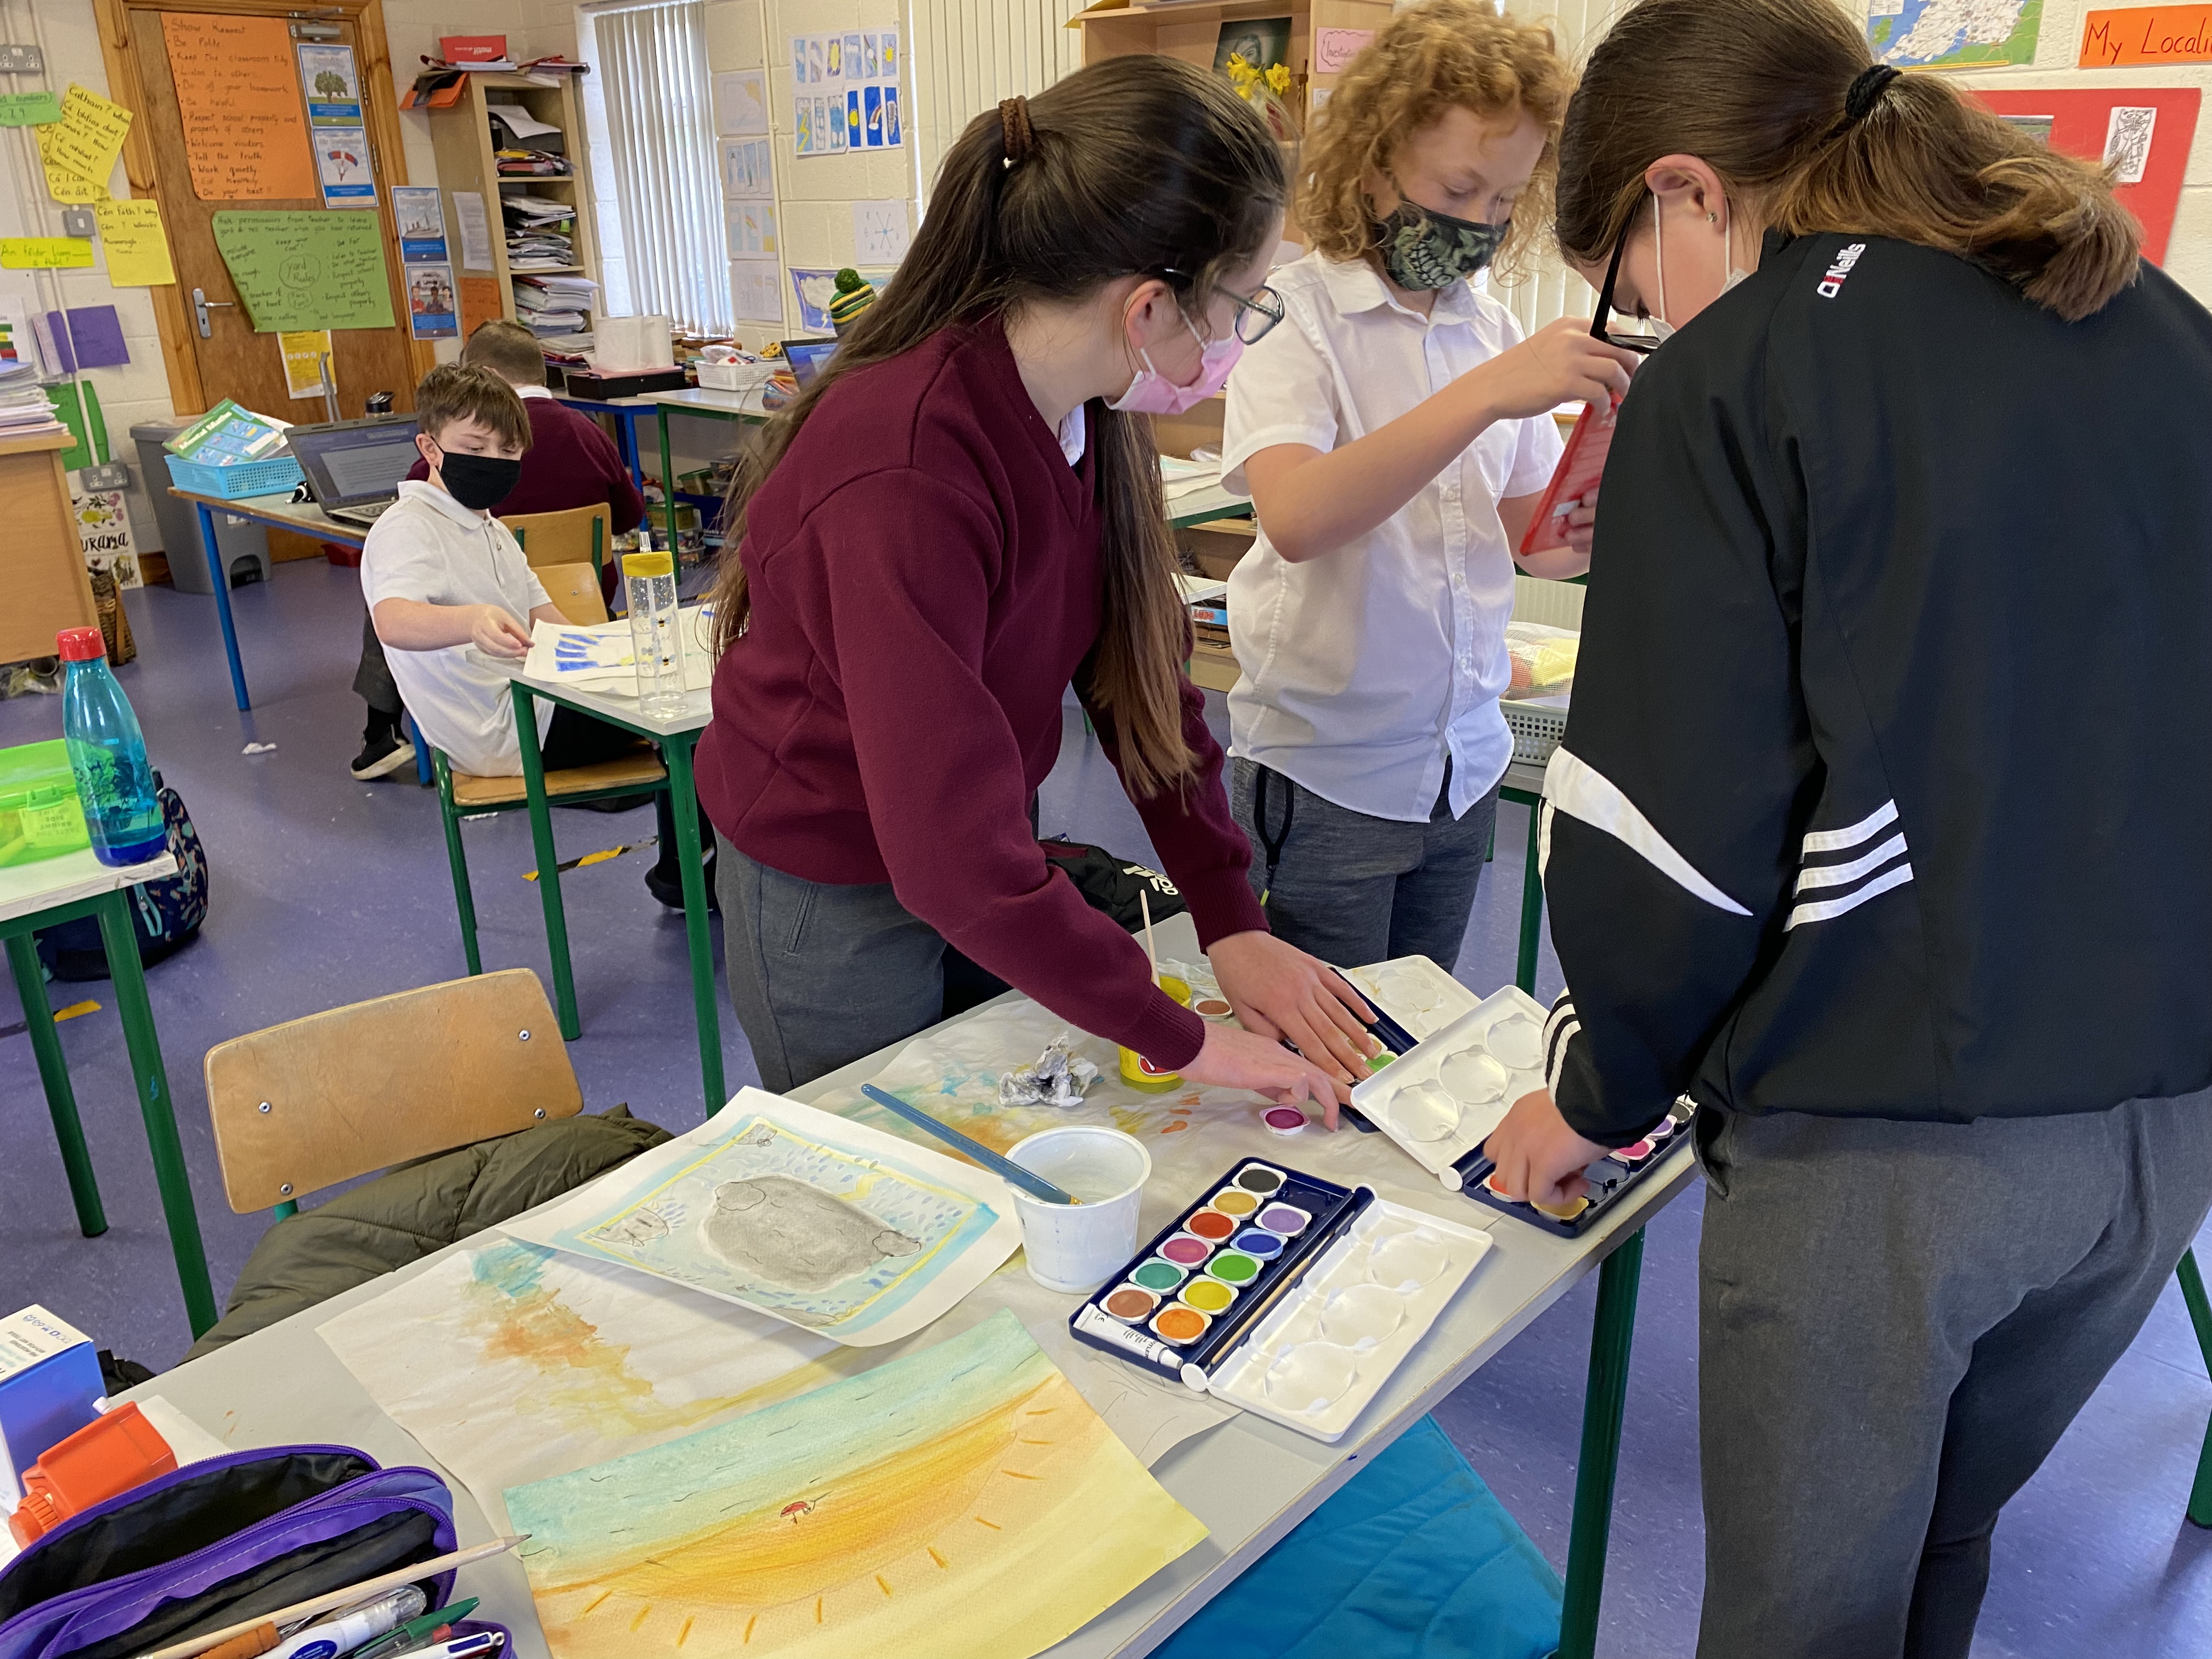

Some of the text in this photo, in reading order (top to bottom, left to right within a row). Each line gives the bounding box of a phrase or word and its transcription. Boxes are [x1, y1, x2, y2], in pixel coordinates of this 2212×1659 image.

[172, 19, 246, 33] Show Respect
[173, 35, 187, 47] Be
[2085, 17, 2212, 65] My Locali
[274, 55, 288, 66] tidy
[180, 66, 205, 76] Listen
[183, 80, 194, 89] Do
[225, 84, 241, 94] your
[250, 82, 289, 93] homework
[210, 97, 235, 108] helpful
[189, 113, 215, 122] Respect
[250, 114, 278, 126] property
[190, 125, 218, 134] property
[224, 124, 231, 135] of
[190, 139, 224, 148] Welcome
[195, 152, 208, 161] Tell
[217, 151, 229, 160] the
[73, 159, 93, 174] much
[198, 165, 257, 177] Work quietly
[203, 188, 214, 196] Do
[292, 271, 316, 282] Rules
[178, 428, 208, 450] Mental
[205, 411, 233, 431] Maths
[1194, 609, 1215, 620] LUDO
